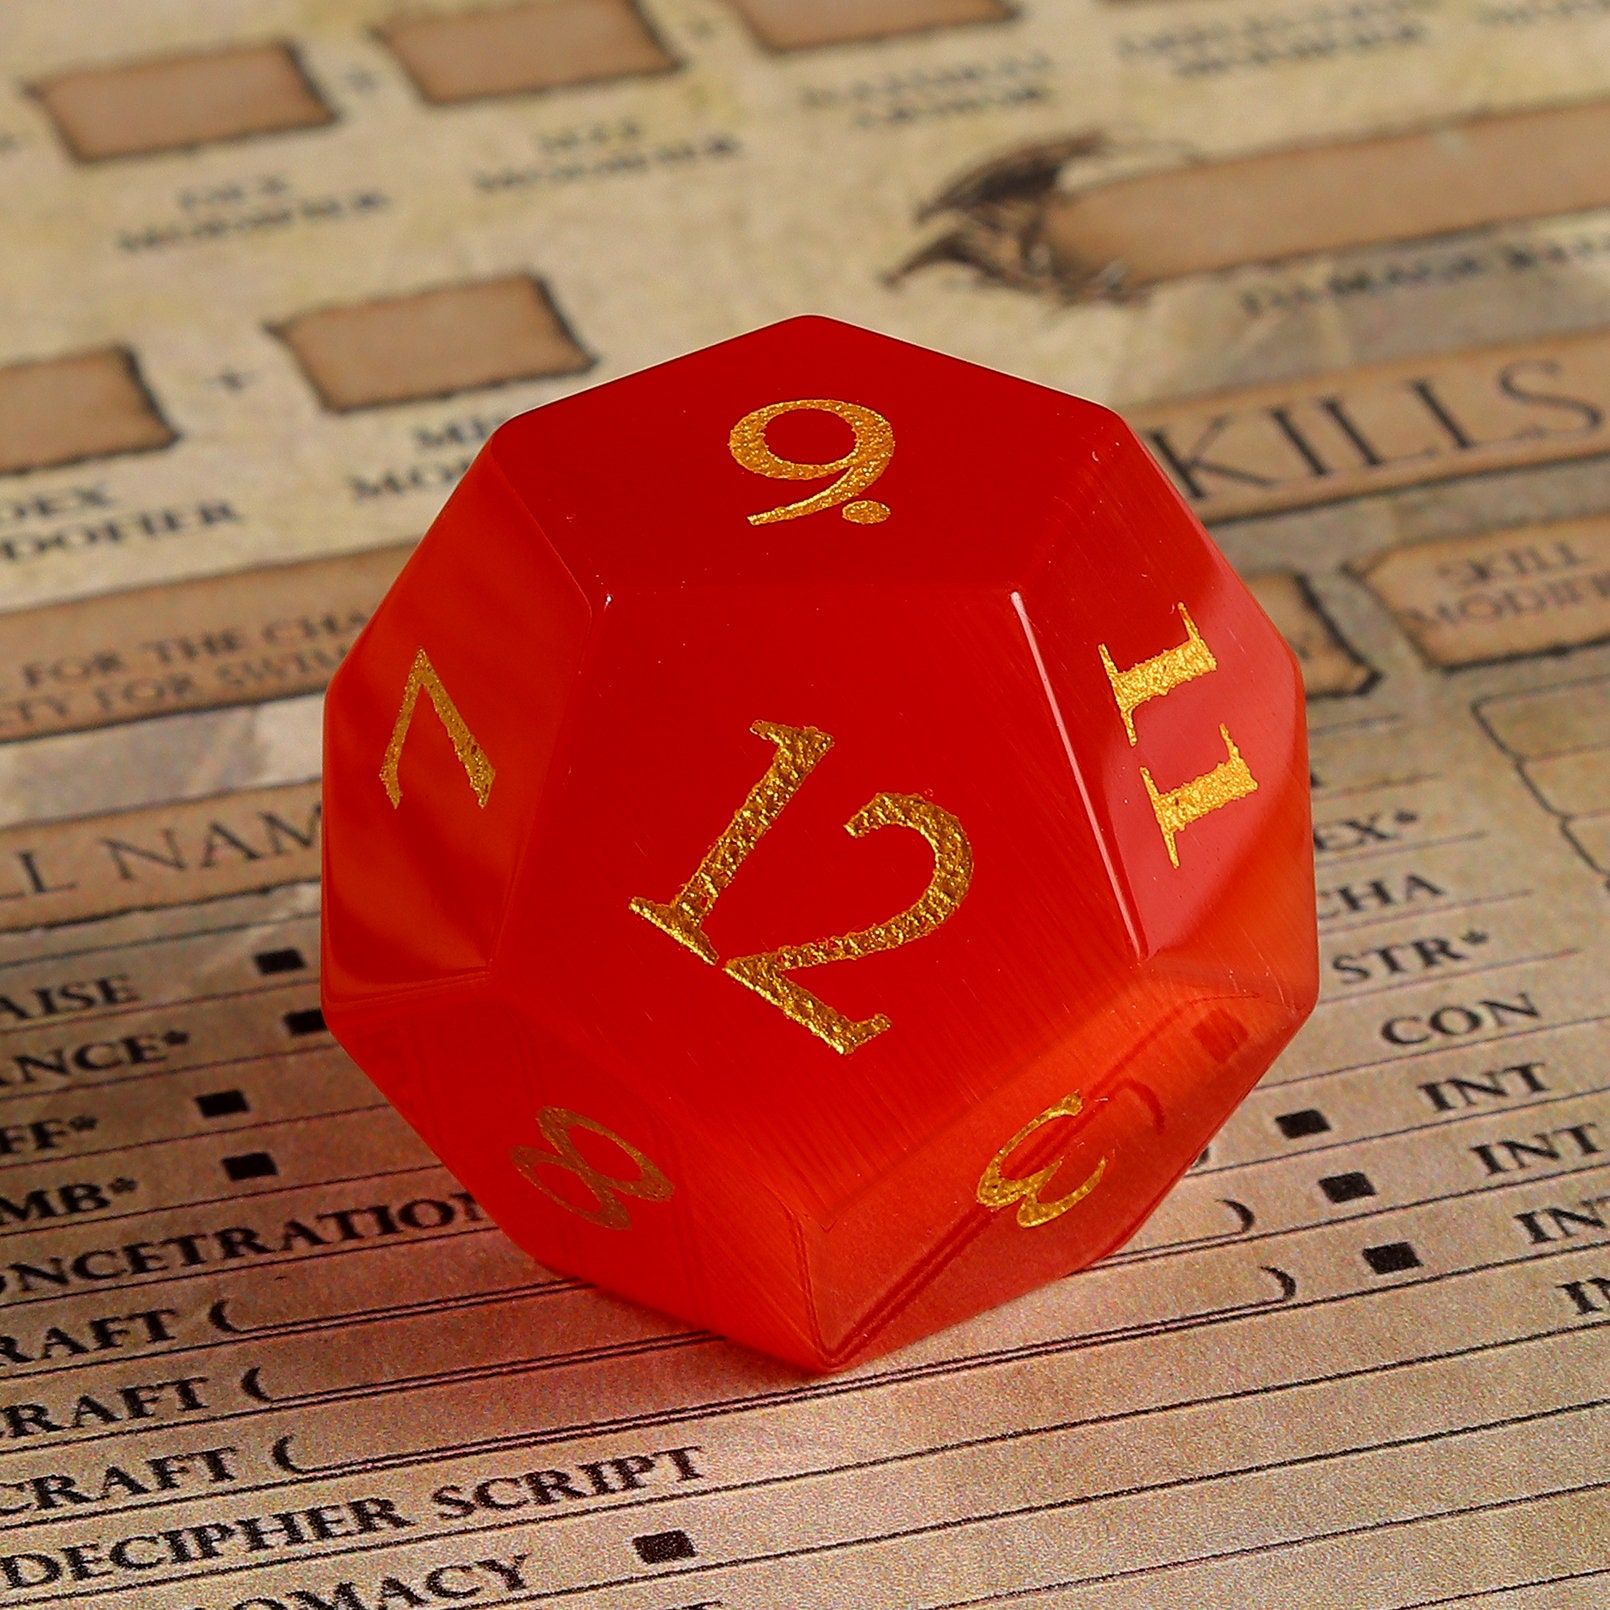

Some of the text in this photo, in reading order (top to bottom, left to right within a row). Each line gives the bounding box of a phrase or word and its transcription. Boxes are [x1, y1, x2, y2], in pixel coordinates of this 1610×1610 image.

[1142, 358, 1605, 501] KILLS
[22, 652, 122, 688] FOR
[140, 629, 240, 664] THE
[379, 648, 496, 810] 7
[1097, 601, 1258, 869] 11
[628, 719, 973, 1056] 12
[1382, 992, 1541, 1047] CON
[1418, 1062, 1554, 1114] INT
[1469, 1122, 1603, 1177] INT
[509, 1103, 676, 1231] 8
[975, 1090, 1107, 1229] 3
[1513, 1196, 1610, 1245] IN
[0, 1445, 704, 1590] DECIPHER SCRIPT
